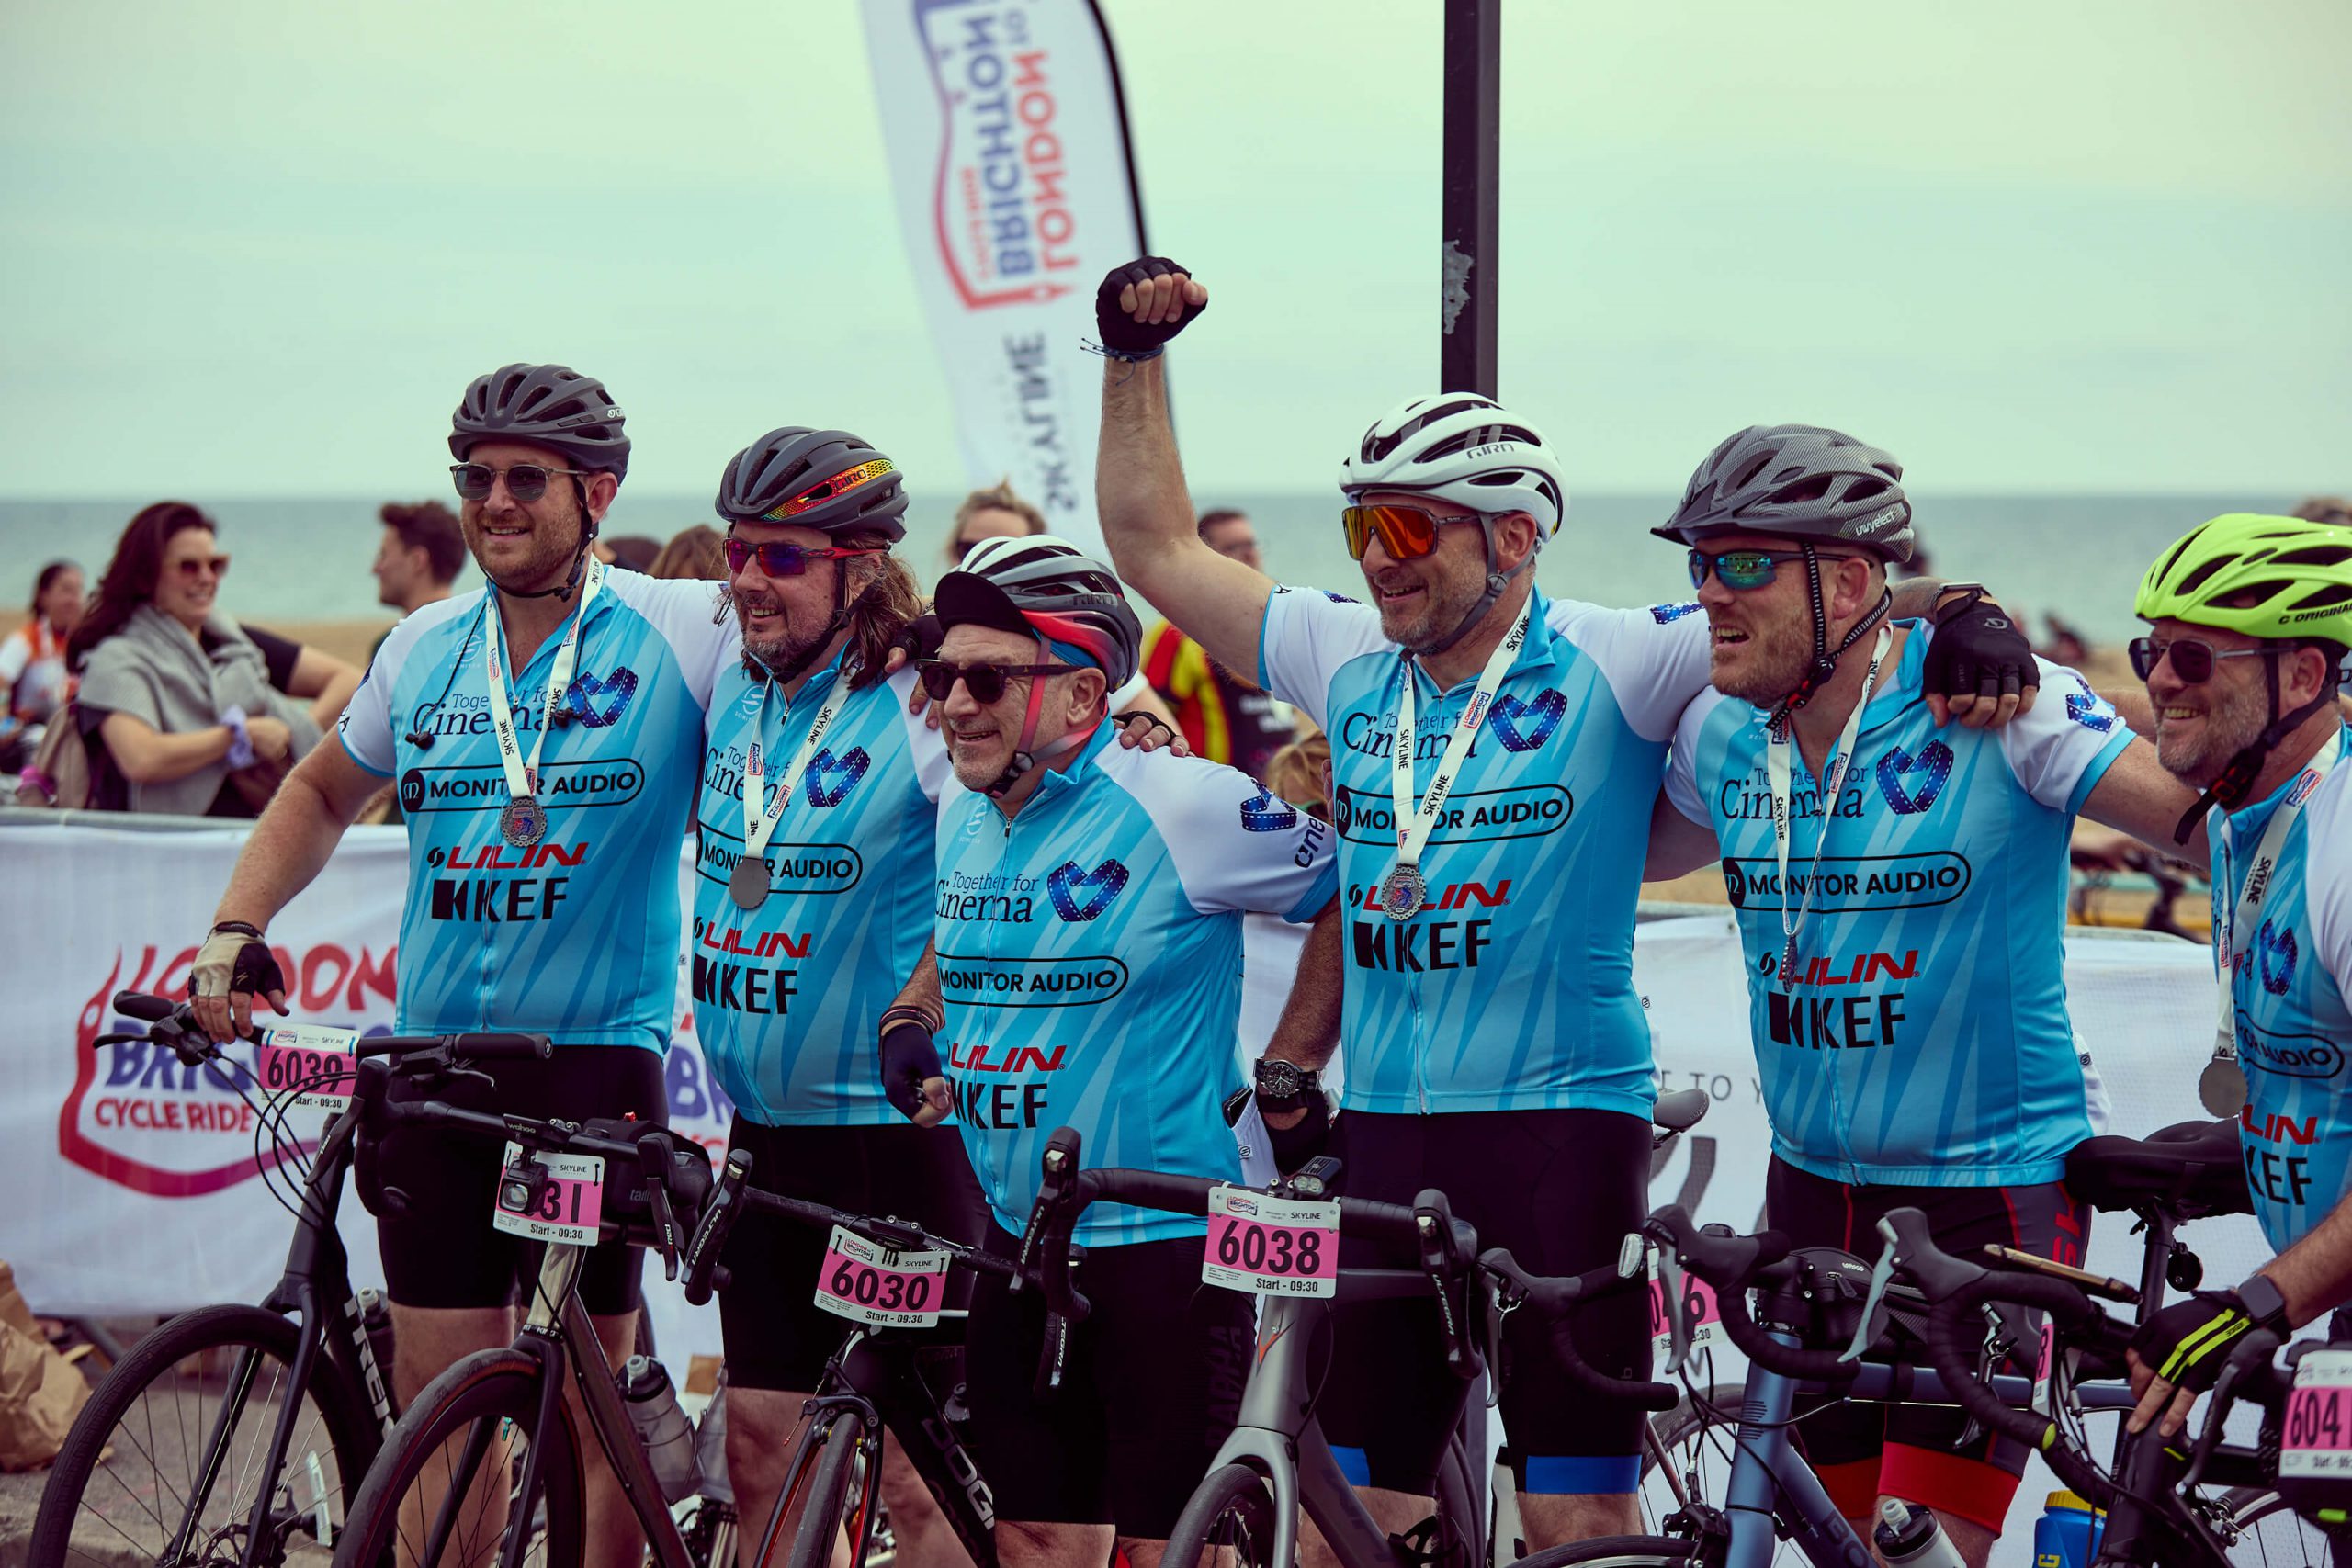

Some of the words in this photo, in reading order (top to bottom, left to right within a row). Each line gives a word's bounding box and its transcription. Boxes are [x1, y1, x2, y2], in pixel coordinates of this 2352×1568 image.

[834, 468, 866, 490] GIRO
[1464, 697, 1478, 724] LONDON
[499, 718, 514, 755] SKYLINE
[807, 706, 832, 746] SKYLINE
[1398, 728, 1409, 770] SKYLINE
[430, 777, 545, 798] MONITR
[551, 771, 636, 795] AUDIO
[1424, 773, 1449, 817] SKYLINE
[1470, 799, 1563, 828] AUDIO
[446, 842, 590, 869] LILIN
[779, 859, 854, 879] AUDIO
[953, 871, 1008, 895] Together
[1012, 873, 1039, 892] for
[1865, 866, 1961, 895] AUDIO
[2247, 856, 2272, 906] SKYLINE
[474, 876, 569, 923] KEF
[934, 878, 1034, 923] Cinema
[703, 921, 812, 959] LILIN
[1394, 919, 1492, 973] KEF
[720, 966, 798, 1015] KEF
[940, 968, 1023, 993] MONITOR
[1029, 970, 1118, 993] AUDIO
[1810, 992, 1906, 1050] KEF
[267, 1049, 344, 1094] 6039
[950, 1043, 1068, 1073] LILIN
[1690, 1073, 1732, 1101] TO
[96, 1099, 185, 1130] CYCLE
[188, 1104, 254, 1134] RIDE
[295, 1096, 313, 1106] Start
[320, 1098, 343, 1109] 09:30
[967, 1081, 1048, 1130] KEF
[507, 1122, 537, 1134] wahoo
[560, 1164, 588, 1174] SKYLINE
[1228, 1196, 1253, 1206] LONDON
[1228, 1201, 1257, 1213] BRIGHTON
[1290, 1211, 1322, 1221] SKYLINE
[529, 1223, 551, 1237] Start
[558, 1226, 584, 1241] 09:30
[692, 1209, 723, 1265] ULTEGRA
[847, 1238, 868, 1252] LONDON
[1021, 1205, 1045, 1265] ULTEGRA
[846, 1243, 872, 1258] BRIGHTON
[1219, 1220, 1322, 1276] 6038
[904, 1259, 933, 1269] SKYLINE
[831, 1259, 931, 1312] 6030
[1255, 1277, 1281, 1292] Start
[1289, 1280, 1319, 1293] 09:30
[865, 1310, 888, 1324] Start
[897, 1314, 923, 1325] 09:30
[1057, 1315, 1068, 1368] LTEGRA
[2290, 1390, 2352, 1448] 604
